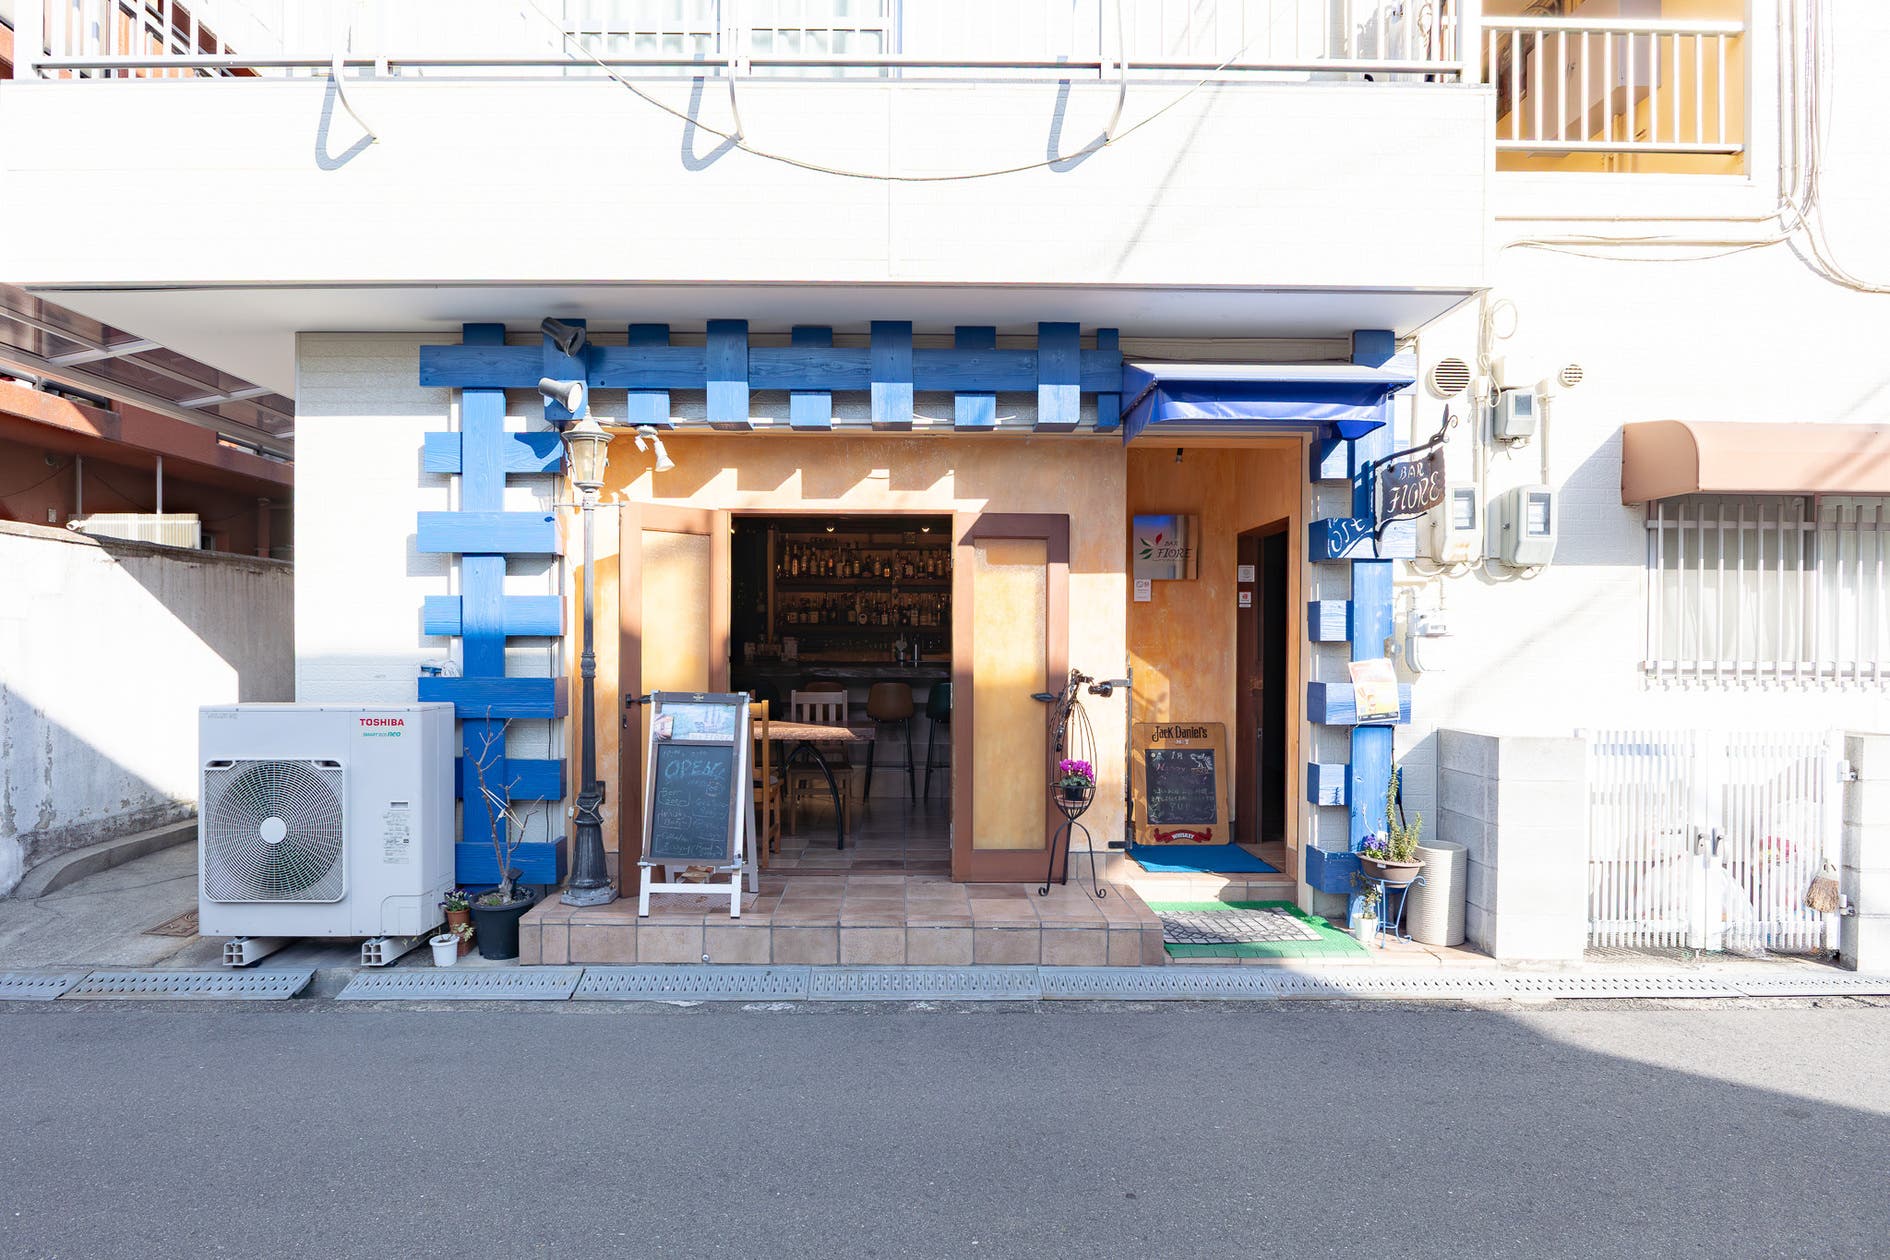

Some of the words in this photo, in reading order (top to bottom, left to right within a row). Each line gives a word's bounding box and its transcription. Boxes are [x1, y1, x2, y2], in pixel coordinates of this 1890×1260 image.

[1400, 462, 1425, 479] BAR
[1387, 471, 1439, 513] FIORE
[1157, 548, 1192, 558] FIORE
[359, 718, 404, 726] TOSHIBA
[1152, 726, 1174, 742] Jack
[1175, 726, 1208, 739] Daniel's
